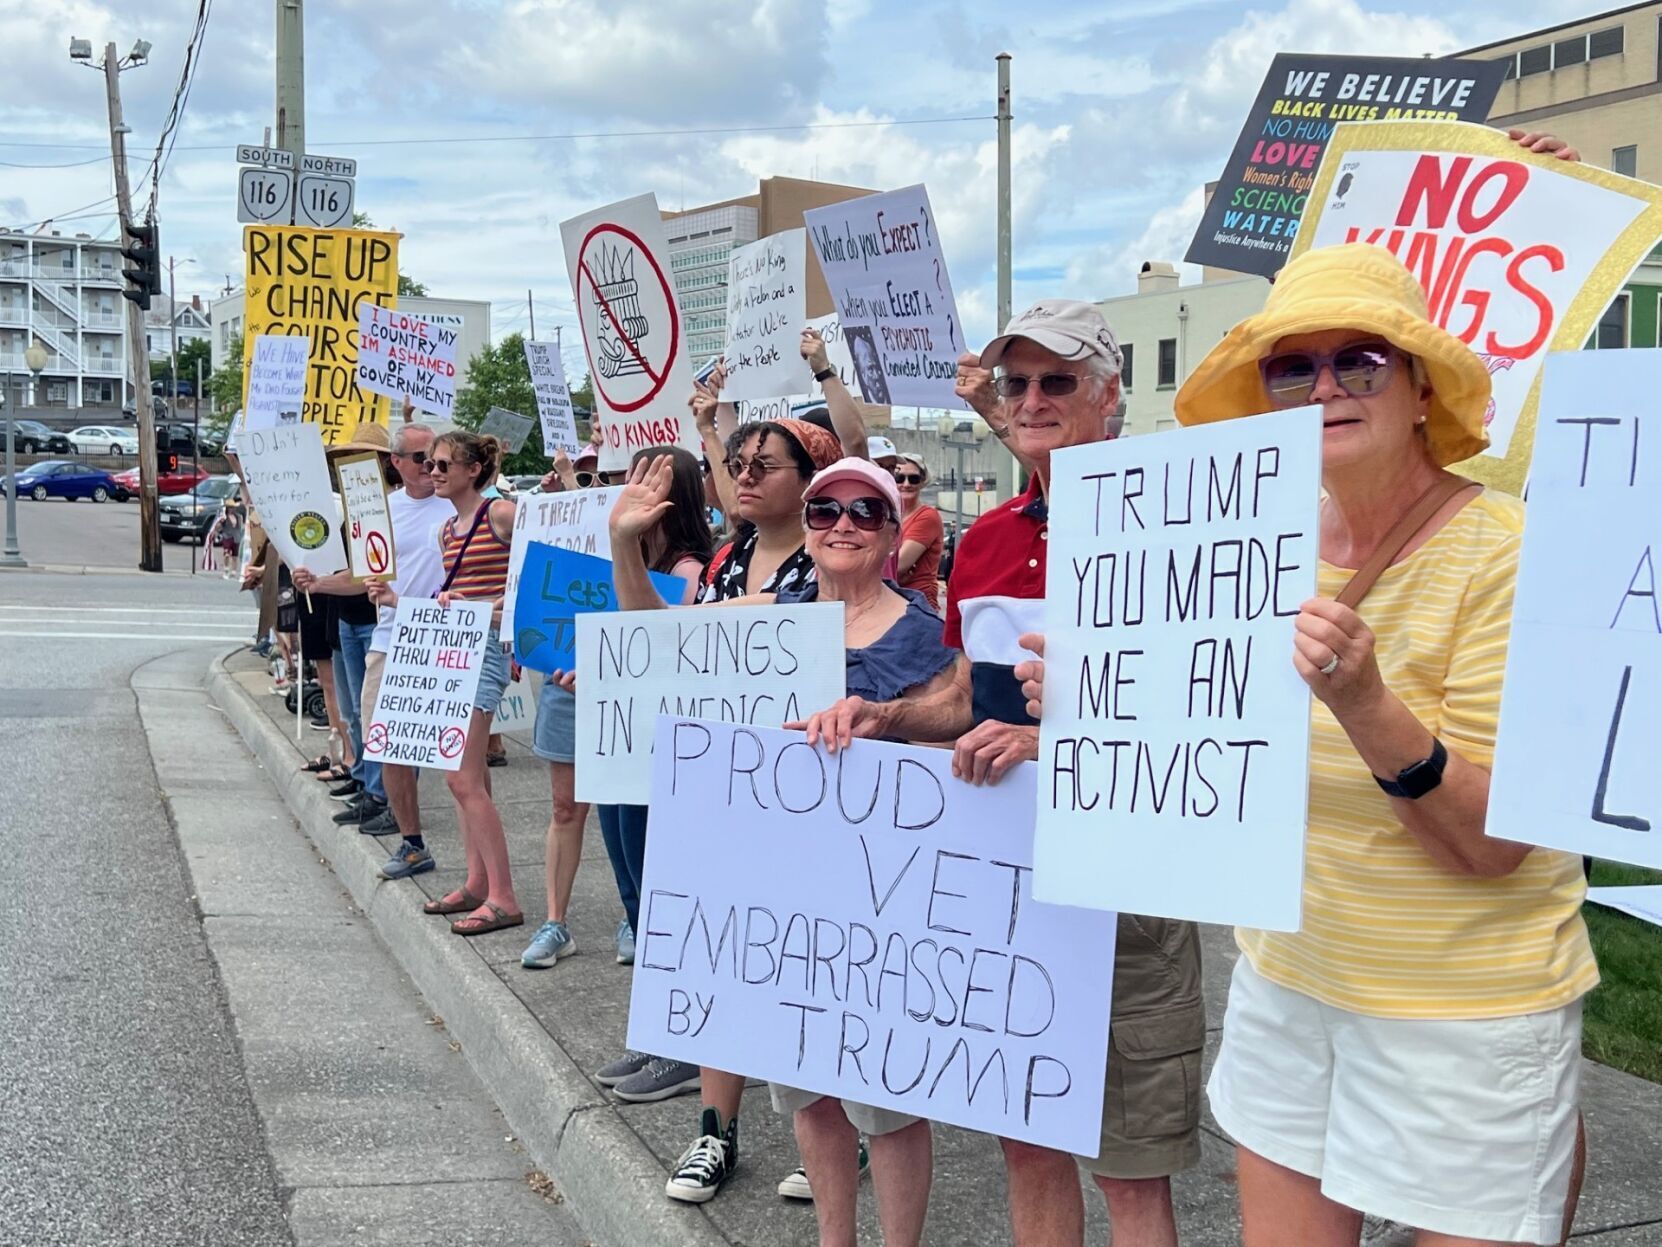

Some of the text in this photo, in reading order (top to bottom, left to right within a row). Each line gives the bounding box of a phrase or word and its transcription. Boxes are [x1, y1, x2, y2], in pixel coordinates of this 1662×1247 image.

[1284, 70, 1475, 108] WE BELIEVE
[1271, 100, 1326, 118] BLACK
[1329, 104, 1379, 121] LIVES
[1262, 118, 1291, 137] NO
[242, 149, 290, 165] SOUTH
[304, 159, 351, 174] NORTH
[1251, 140, 1321, 169] LOVE
[1242, 166, 1287, 187] Women's
[251, 181, 276, 204] 116
[312, 188, 338, 212] 116
[1394, 154, 1530, 234] NO
[1223, 210, 1300, 238] WATER
[813, 225, 846, 263] What
[846, 220, 859, 259] do
[858, 233, 881, 271] you
[1214, 230, 1241, 245] Injustice
[1241, 235, 1275, 251] Anywhere
[250, 231, 391, 282] RISE UP
[767, 248, 786, 275] King
[749, 283, 770, 308] Felon
[772, 282, 785, 300] and
[789, 284, 794, 294] a
[841, 280, 934, 327] When you ELECT A
[1344, 227, 1565, 360] NGS
[371, 324, 437, 355] COUNTRY
[373, 308, 379, 321] I
[390, 313, 428, 338] LOVE
[438, 329, 457, 346] MY
[881, 326, 933, 352] PSYCHOTIC
[389, 345, 454, 377] ASHAMED
[739, 352, 752, 370] the
[753, 344, 781, 368] People
[883, 353, 921, 377] Convicted
[360, 366, 453, 407] GOVERNMENT
[388, 360, 435, 384] OF MY
[605, 418, 680, 448] NO KINGS!
[170, 456, 176, 469] 9
[1081, 447, 1279, 536] TRUMP
[516, 494, 607, 529] A THREAT TO
[1073, 532, 1303, 627] YOU MADE
[411, 608, 475, 626] HERE TO
[392, 645, 430, 666] THRU
[599, 619, 798, 680] NO KINGS
[445, 679, 462, 692] OF
[1079, 635, 1252, 720] ME AN
[424, 699, 445, 716] AT
[445, 700, 471, 719] HIS
[596, 697, 633, 756] IN
[383, 742, 437, 763] PARADE
[672, 722, 945, 830] PROUD
[1053, 737, 1269, 822] ACTIVIST
[860, 834, 1032, 944] VET
[642, 889, 1055, 1037] EMBARRASSED
[667, 989, 1071, 1126] BY TRUMP
